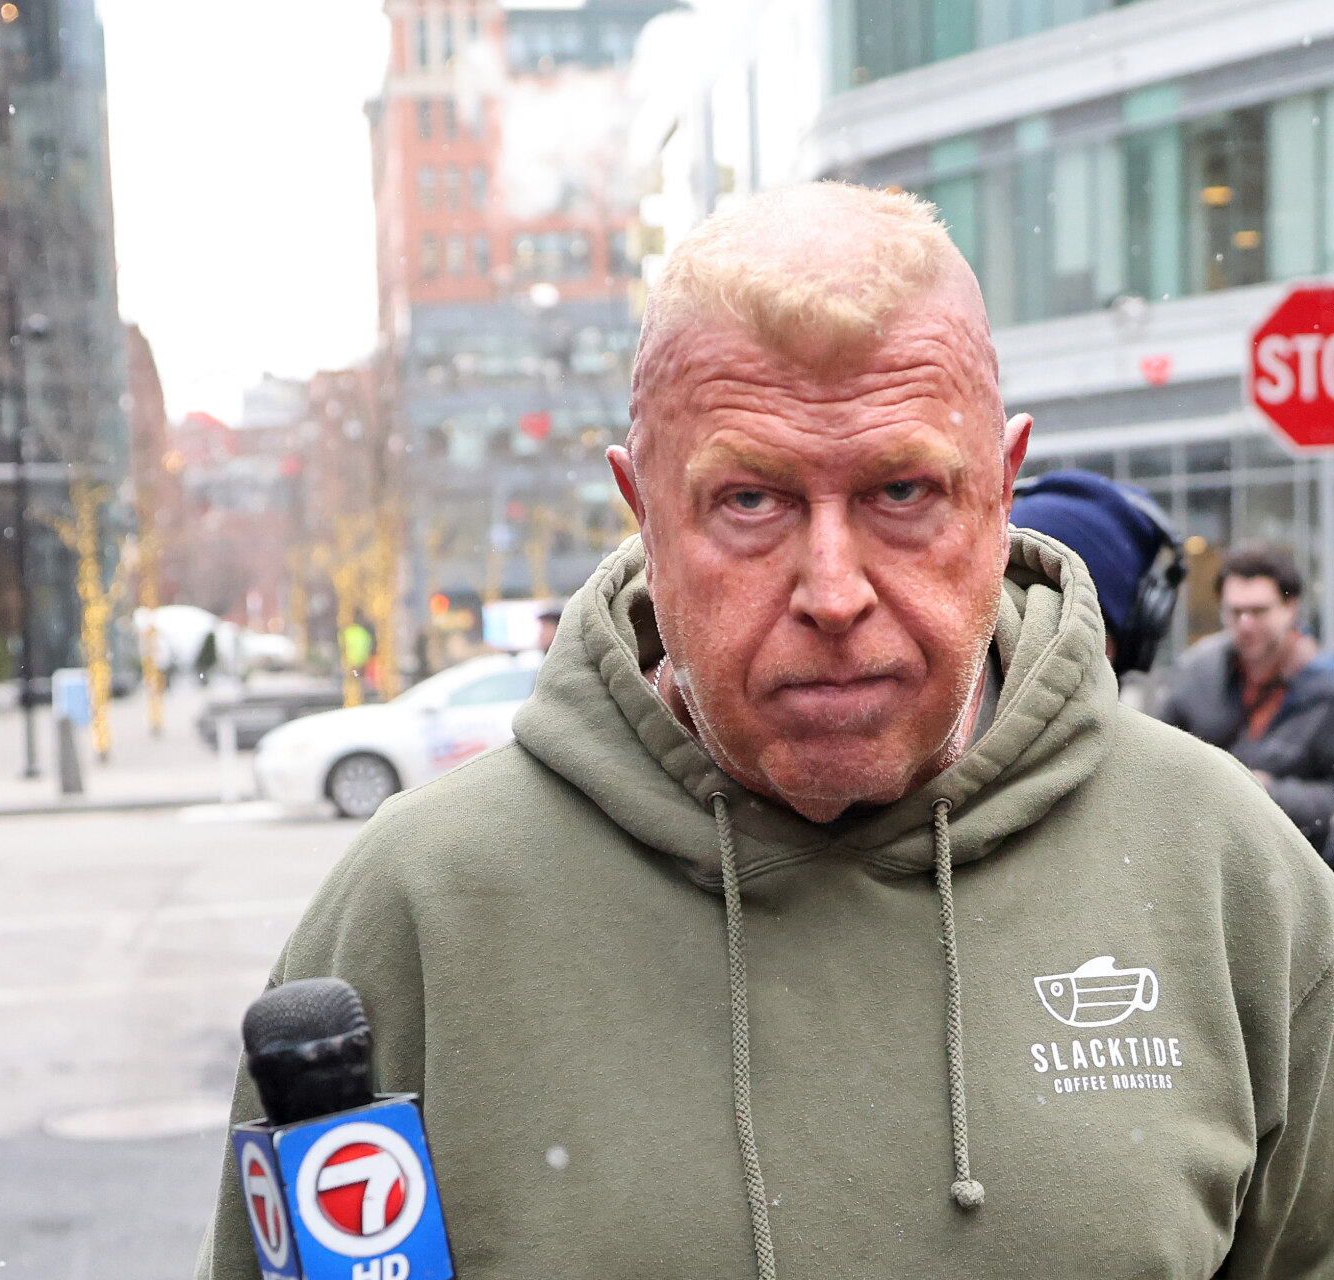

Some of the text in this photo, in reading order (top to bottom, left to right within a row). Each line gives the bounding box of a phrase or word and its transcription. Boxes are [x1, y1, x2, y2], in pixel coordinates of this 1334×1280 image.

[1030, 1037, 1183, 1073] SLACKTIDE
[1053, 1074, 1173, 1094] COFFEE ROASTERS
[318, 1150, 404, 1236] 7
